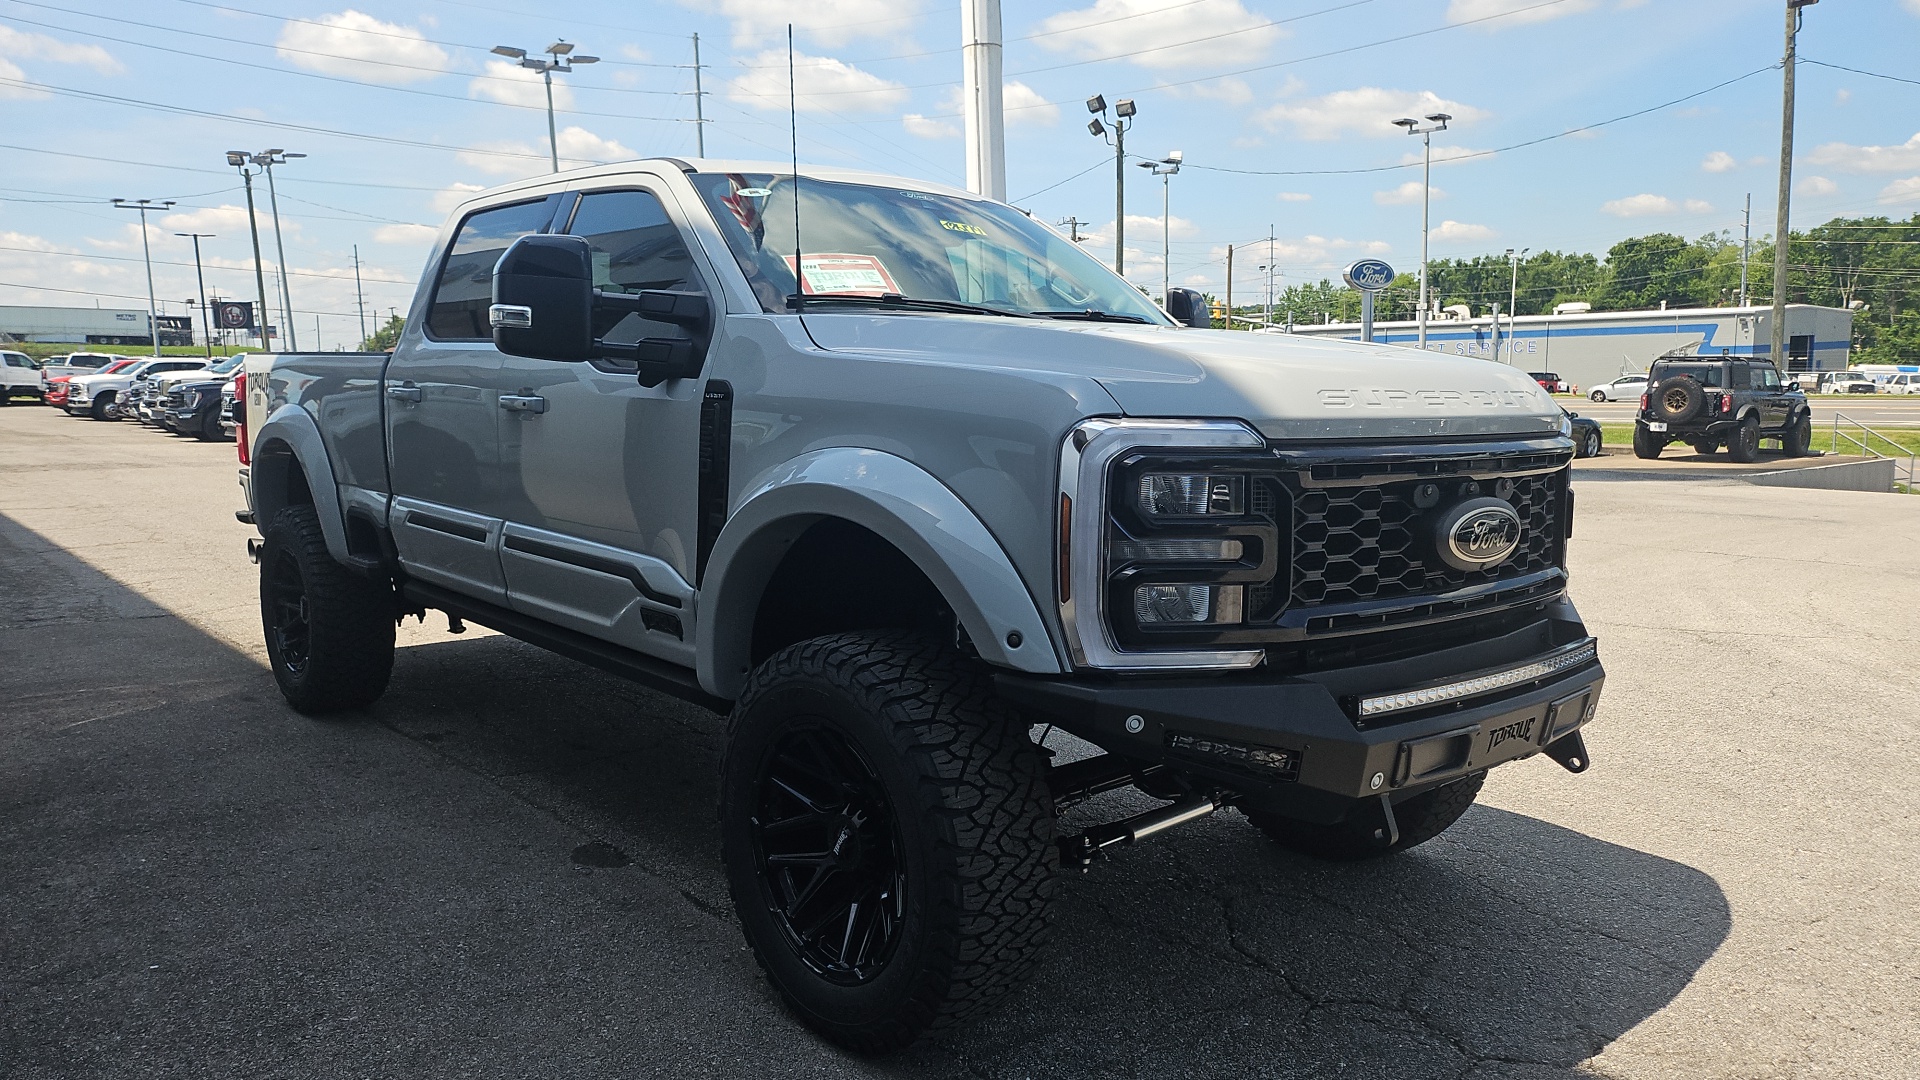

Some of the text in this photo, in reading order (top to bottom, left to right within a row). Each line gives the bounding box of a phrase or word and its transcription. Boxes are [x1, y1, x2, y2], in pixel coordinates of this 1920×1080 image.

[1360, 264, 1388, 284] Ford
[1316, 389, 1471, 409] SUPER
[1469, 519, 1508, 551] Ford
[1486, 716, 1536, 754] TORQUE
